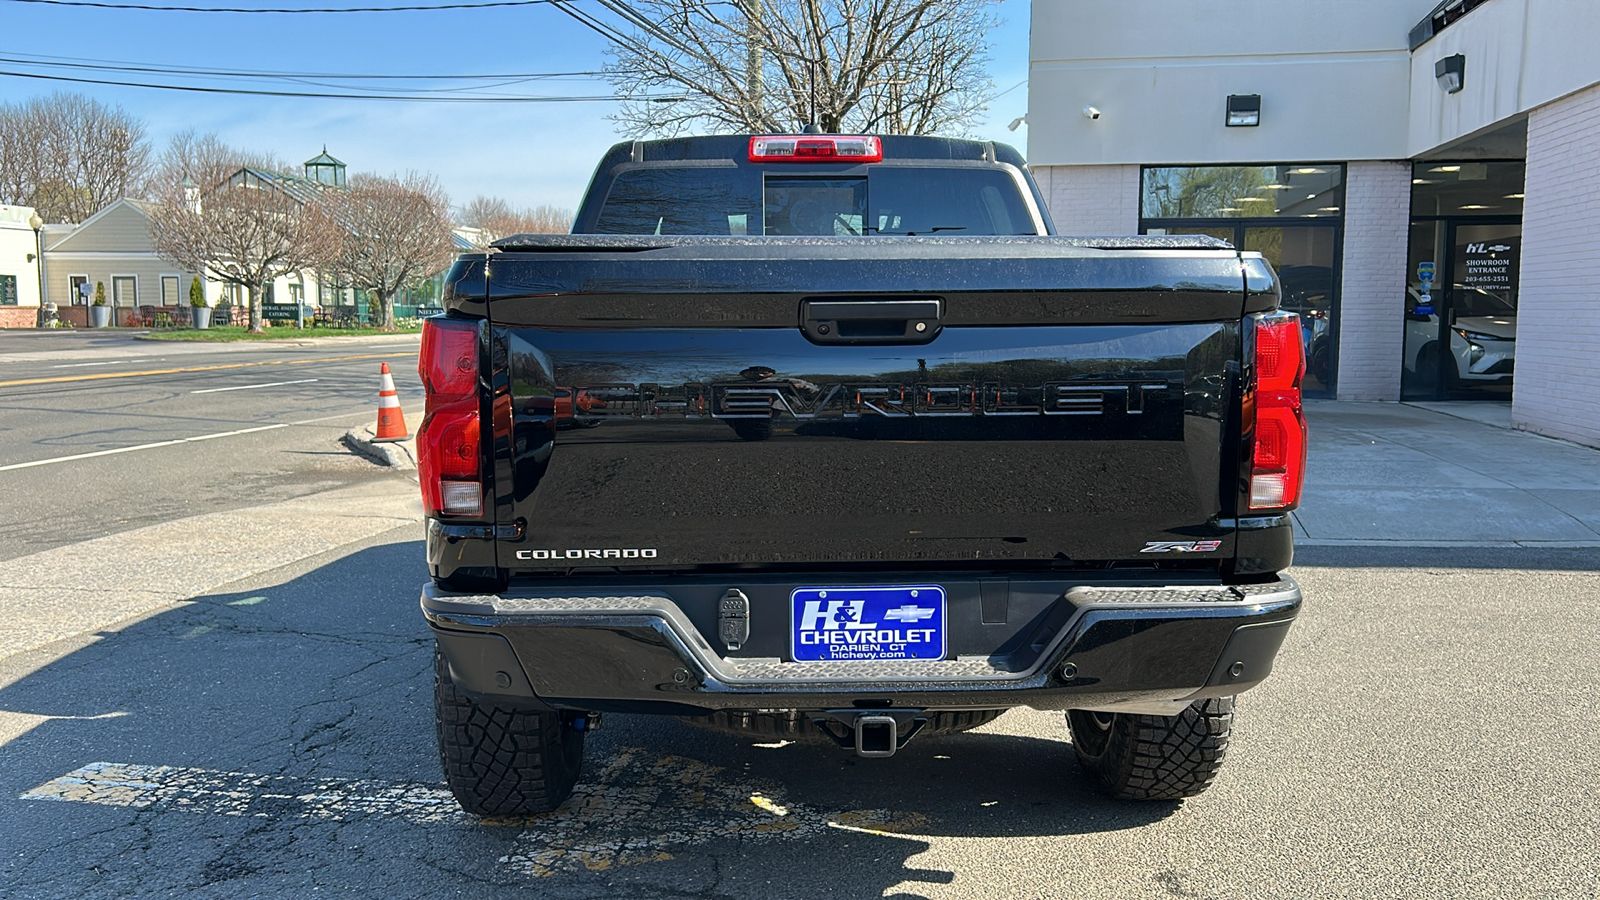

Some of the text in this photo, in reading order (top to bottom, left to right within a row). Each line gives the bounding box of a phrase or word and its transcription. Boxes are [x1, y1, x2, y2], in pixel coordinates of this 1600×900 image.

[573, 380, 1168, 419] CHEVROLET
[1139, 540, 1222, 553] ZR2
[515, 548, 658, 560] COLORADO
[800, 600, 878, 630] H&L
[800, 629, 936, 645] CHEVROLET
[829, 643, 907, 652] DARIEN, CT
[831, 651, 906, 659] hlchevy.com
